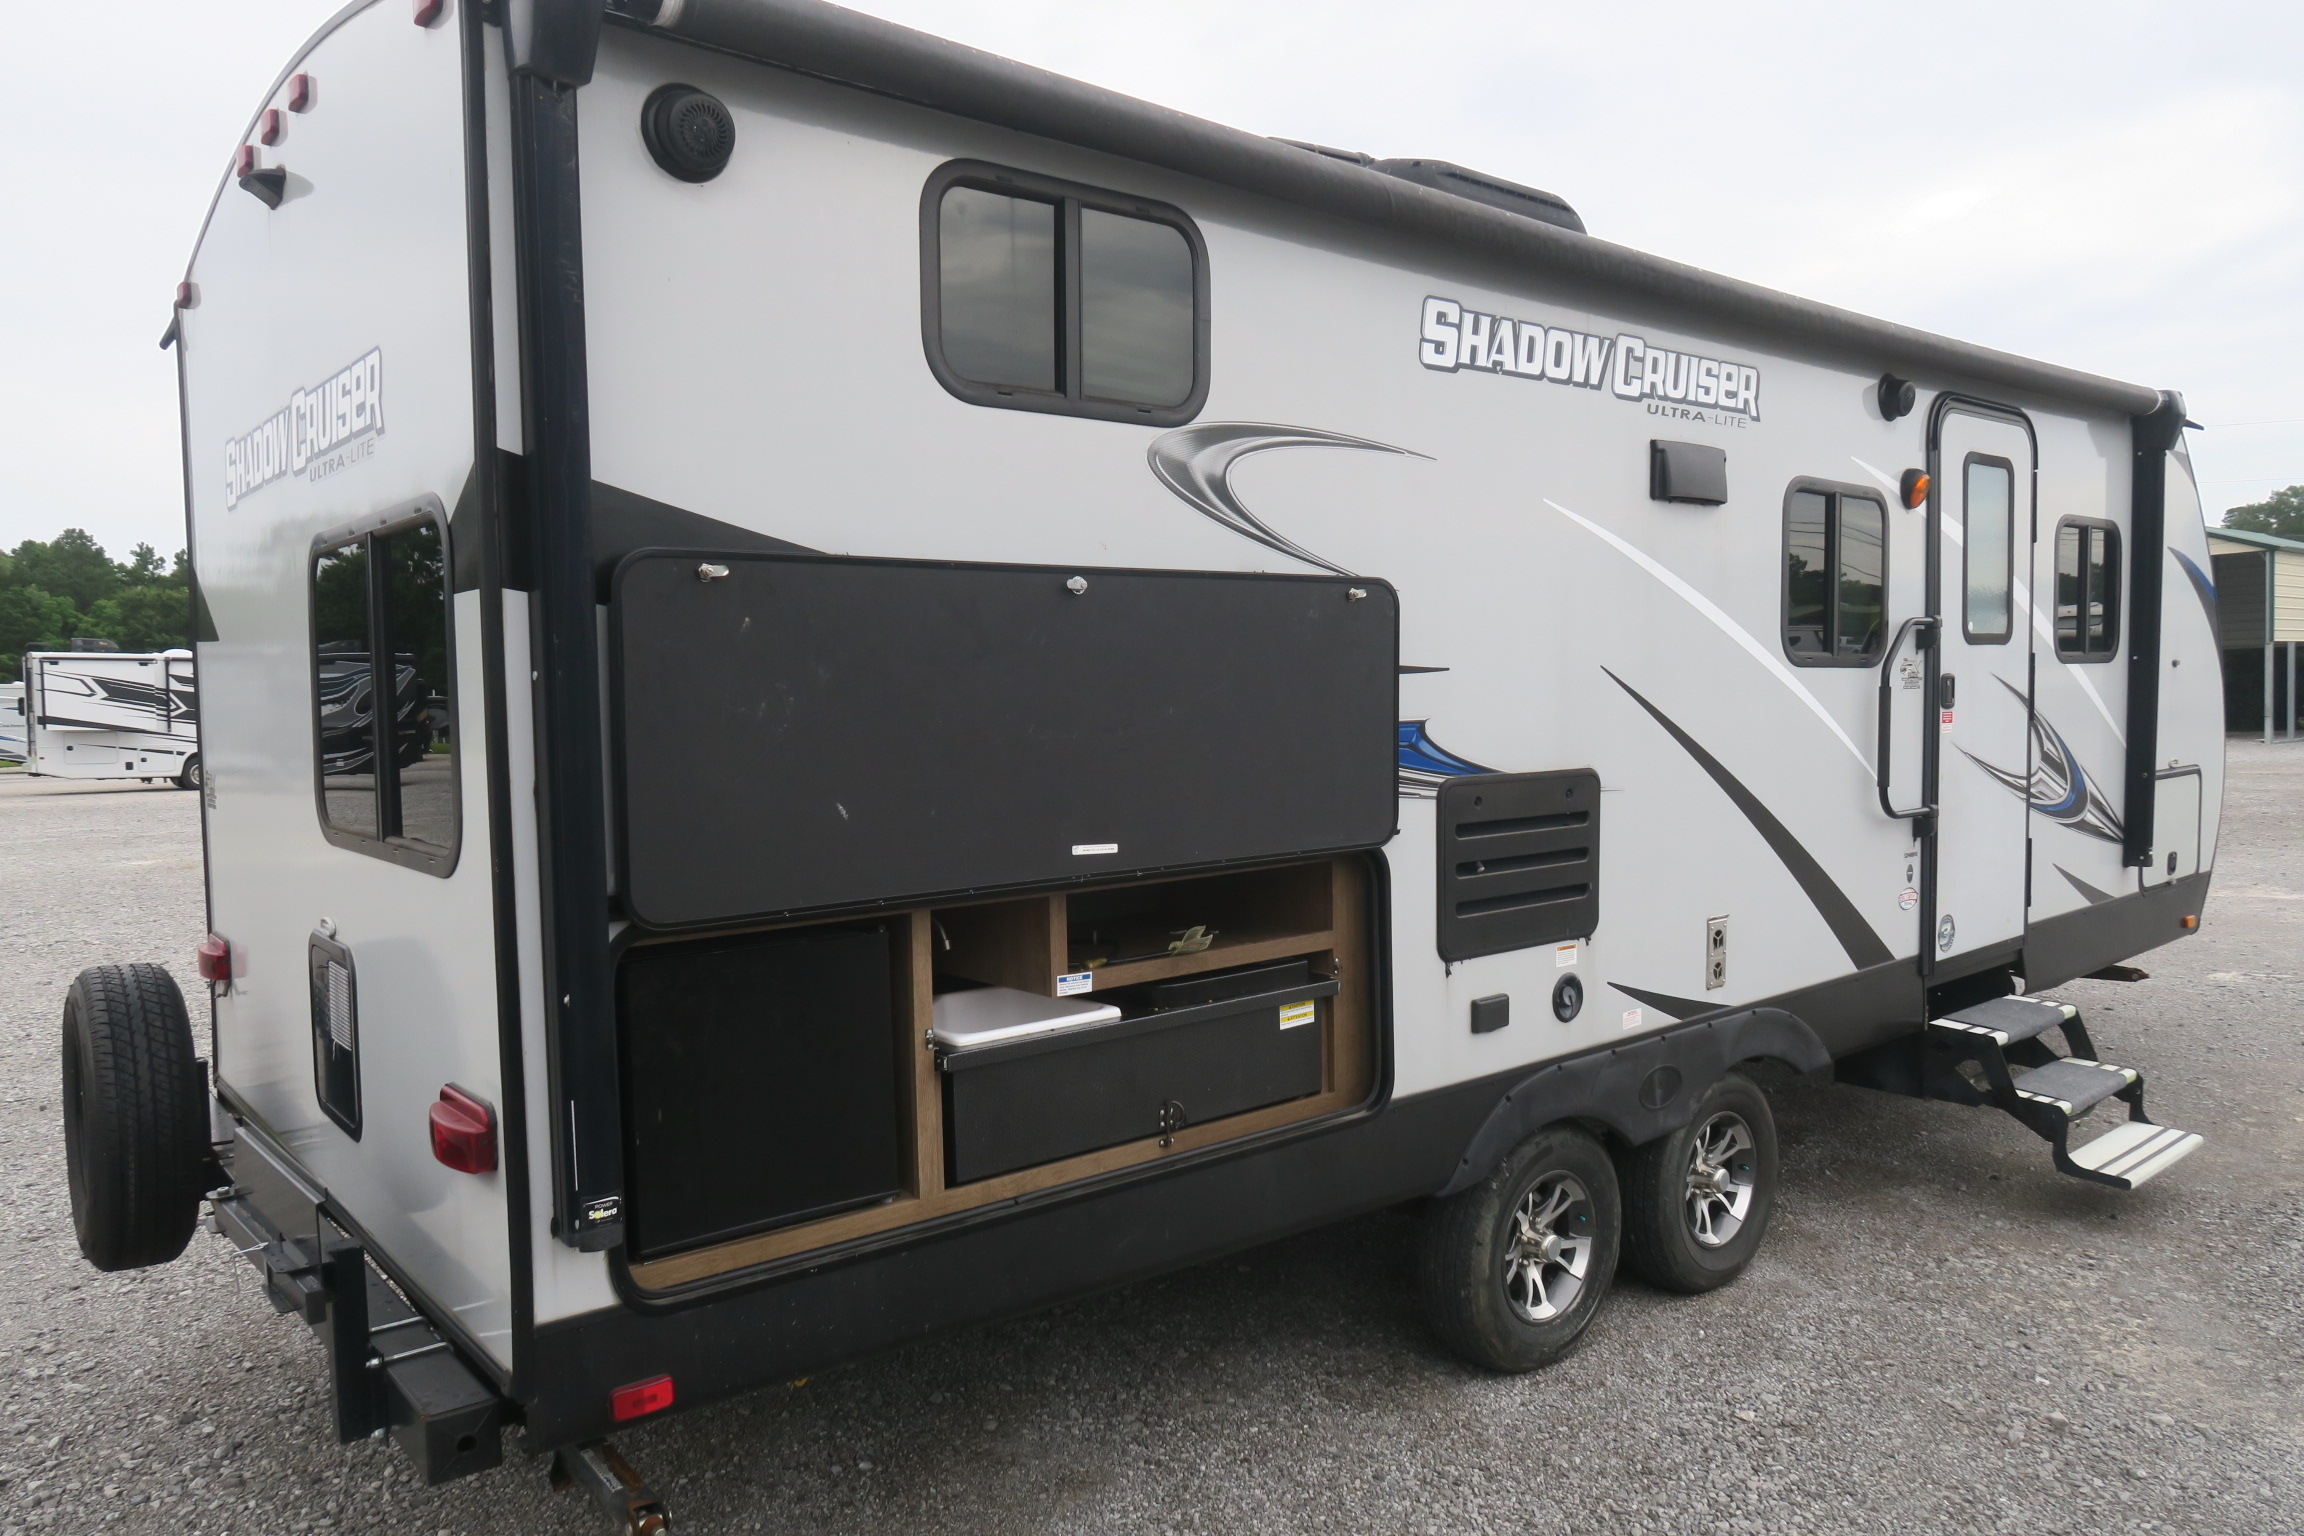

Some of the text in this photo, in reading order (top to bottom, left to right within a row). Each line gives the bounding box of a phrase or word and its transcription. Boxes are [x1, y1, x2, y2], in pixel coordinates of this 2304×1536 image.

[1419, 295, 1613, 391] SHADOW
[1647, 403, 1747, 429] ULTRA-LITE
[225, 404, 290, 512] SHADOW
[309, 437, 376, 483] ULTRA-LITE
[588, 1207, 617, 1219] Solera
